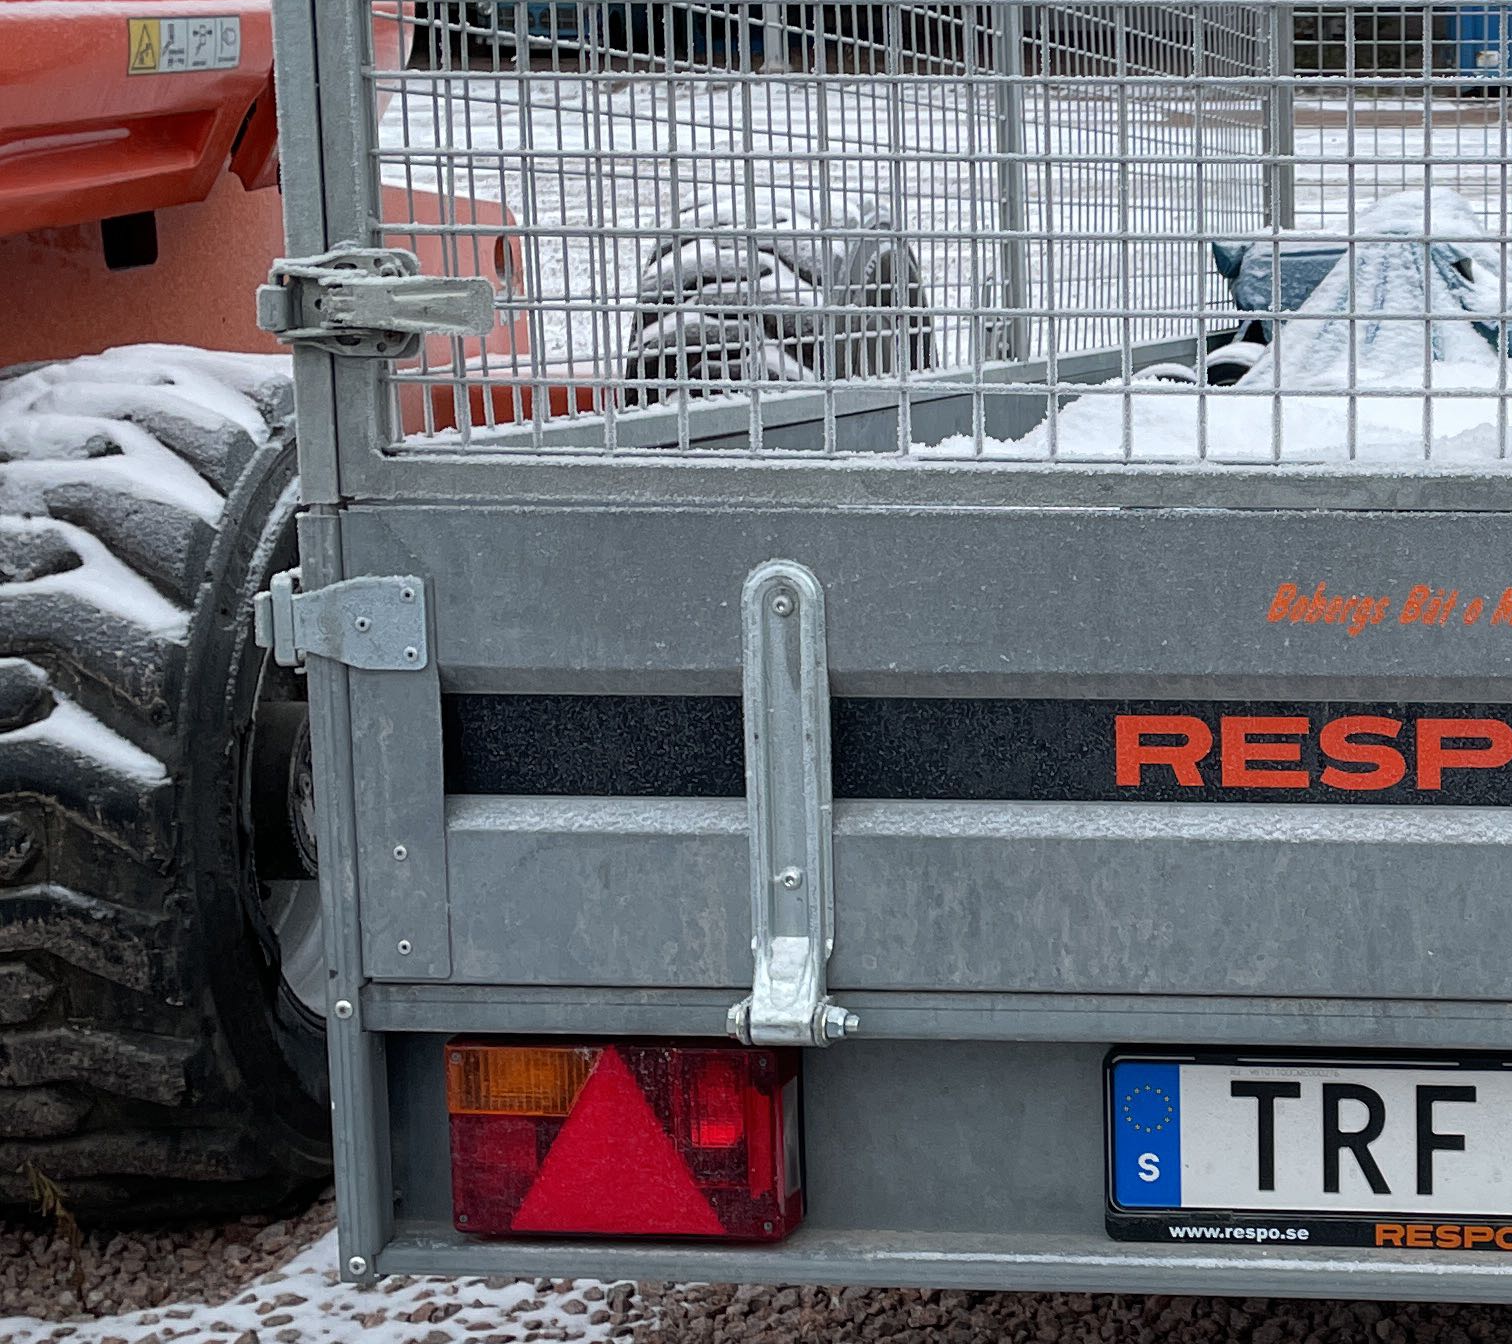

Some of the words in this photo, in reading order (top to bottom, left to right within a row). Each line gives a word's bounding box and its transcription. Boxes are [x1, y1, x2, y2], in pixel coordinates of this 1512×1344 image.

[1266, 581, 1391, 636] Bobergs
[1230, 1079, 1478, 1196] TRF
[1137, 1152, 1161, 1183] S
[1168, 1225, 1310, 1242] www.respo.se
